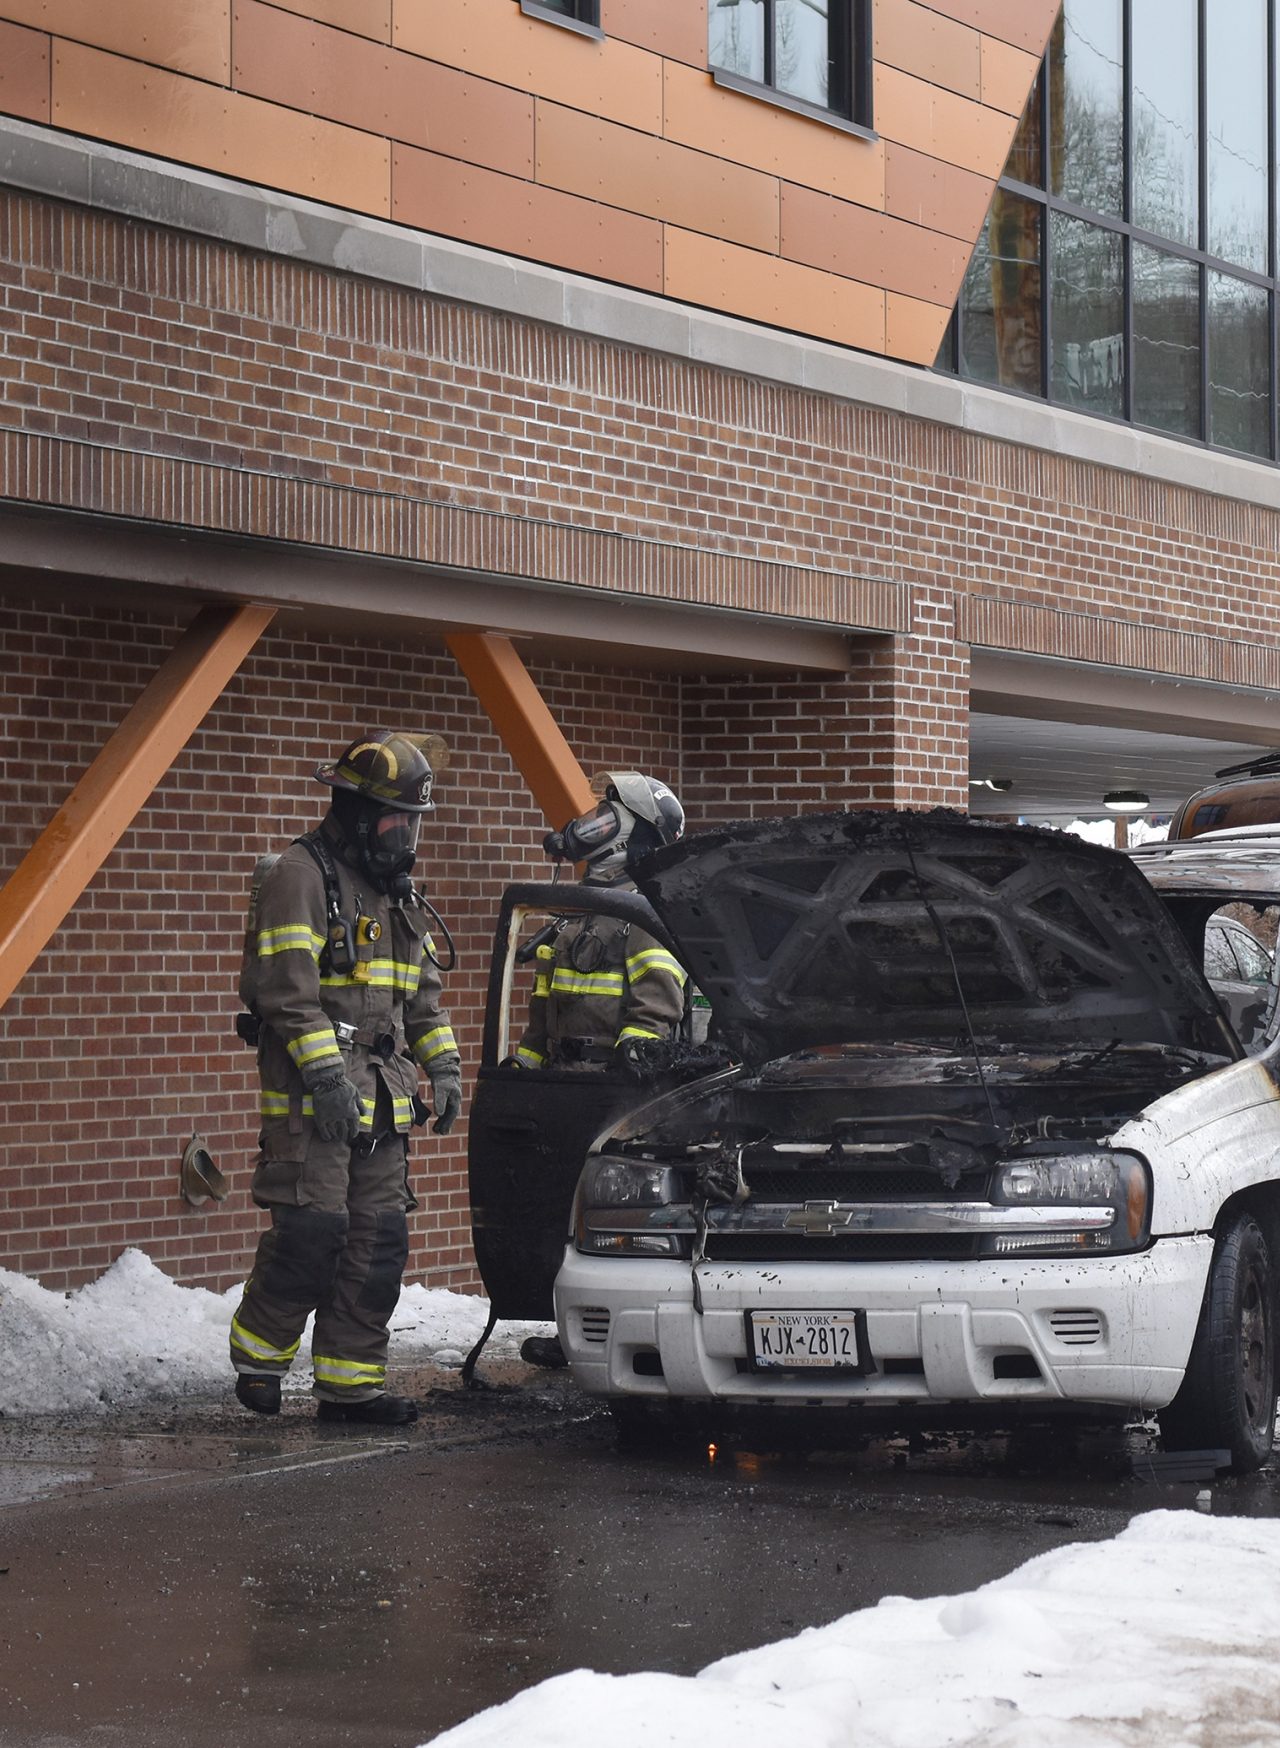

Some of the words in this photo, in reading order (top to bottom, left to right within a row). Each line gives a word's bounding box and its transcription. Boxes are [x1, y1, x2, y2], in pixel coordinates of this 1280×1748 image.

[778, 1315, 801, 1326] NEW
[804, 1315, 831, 1326] YORK
[761, 1327, 795, 1355] KJX
[807, 1327, 851, 1355] 2812
